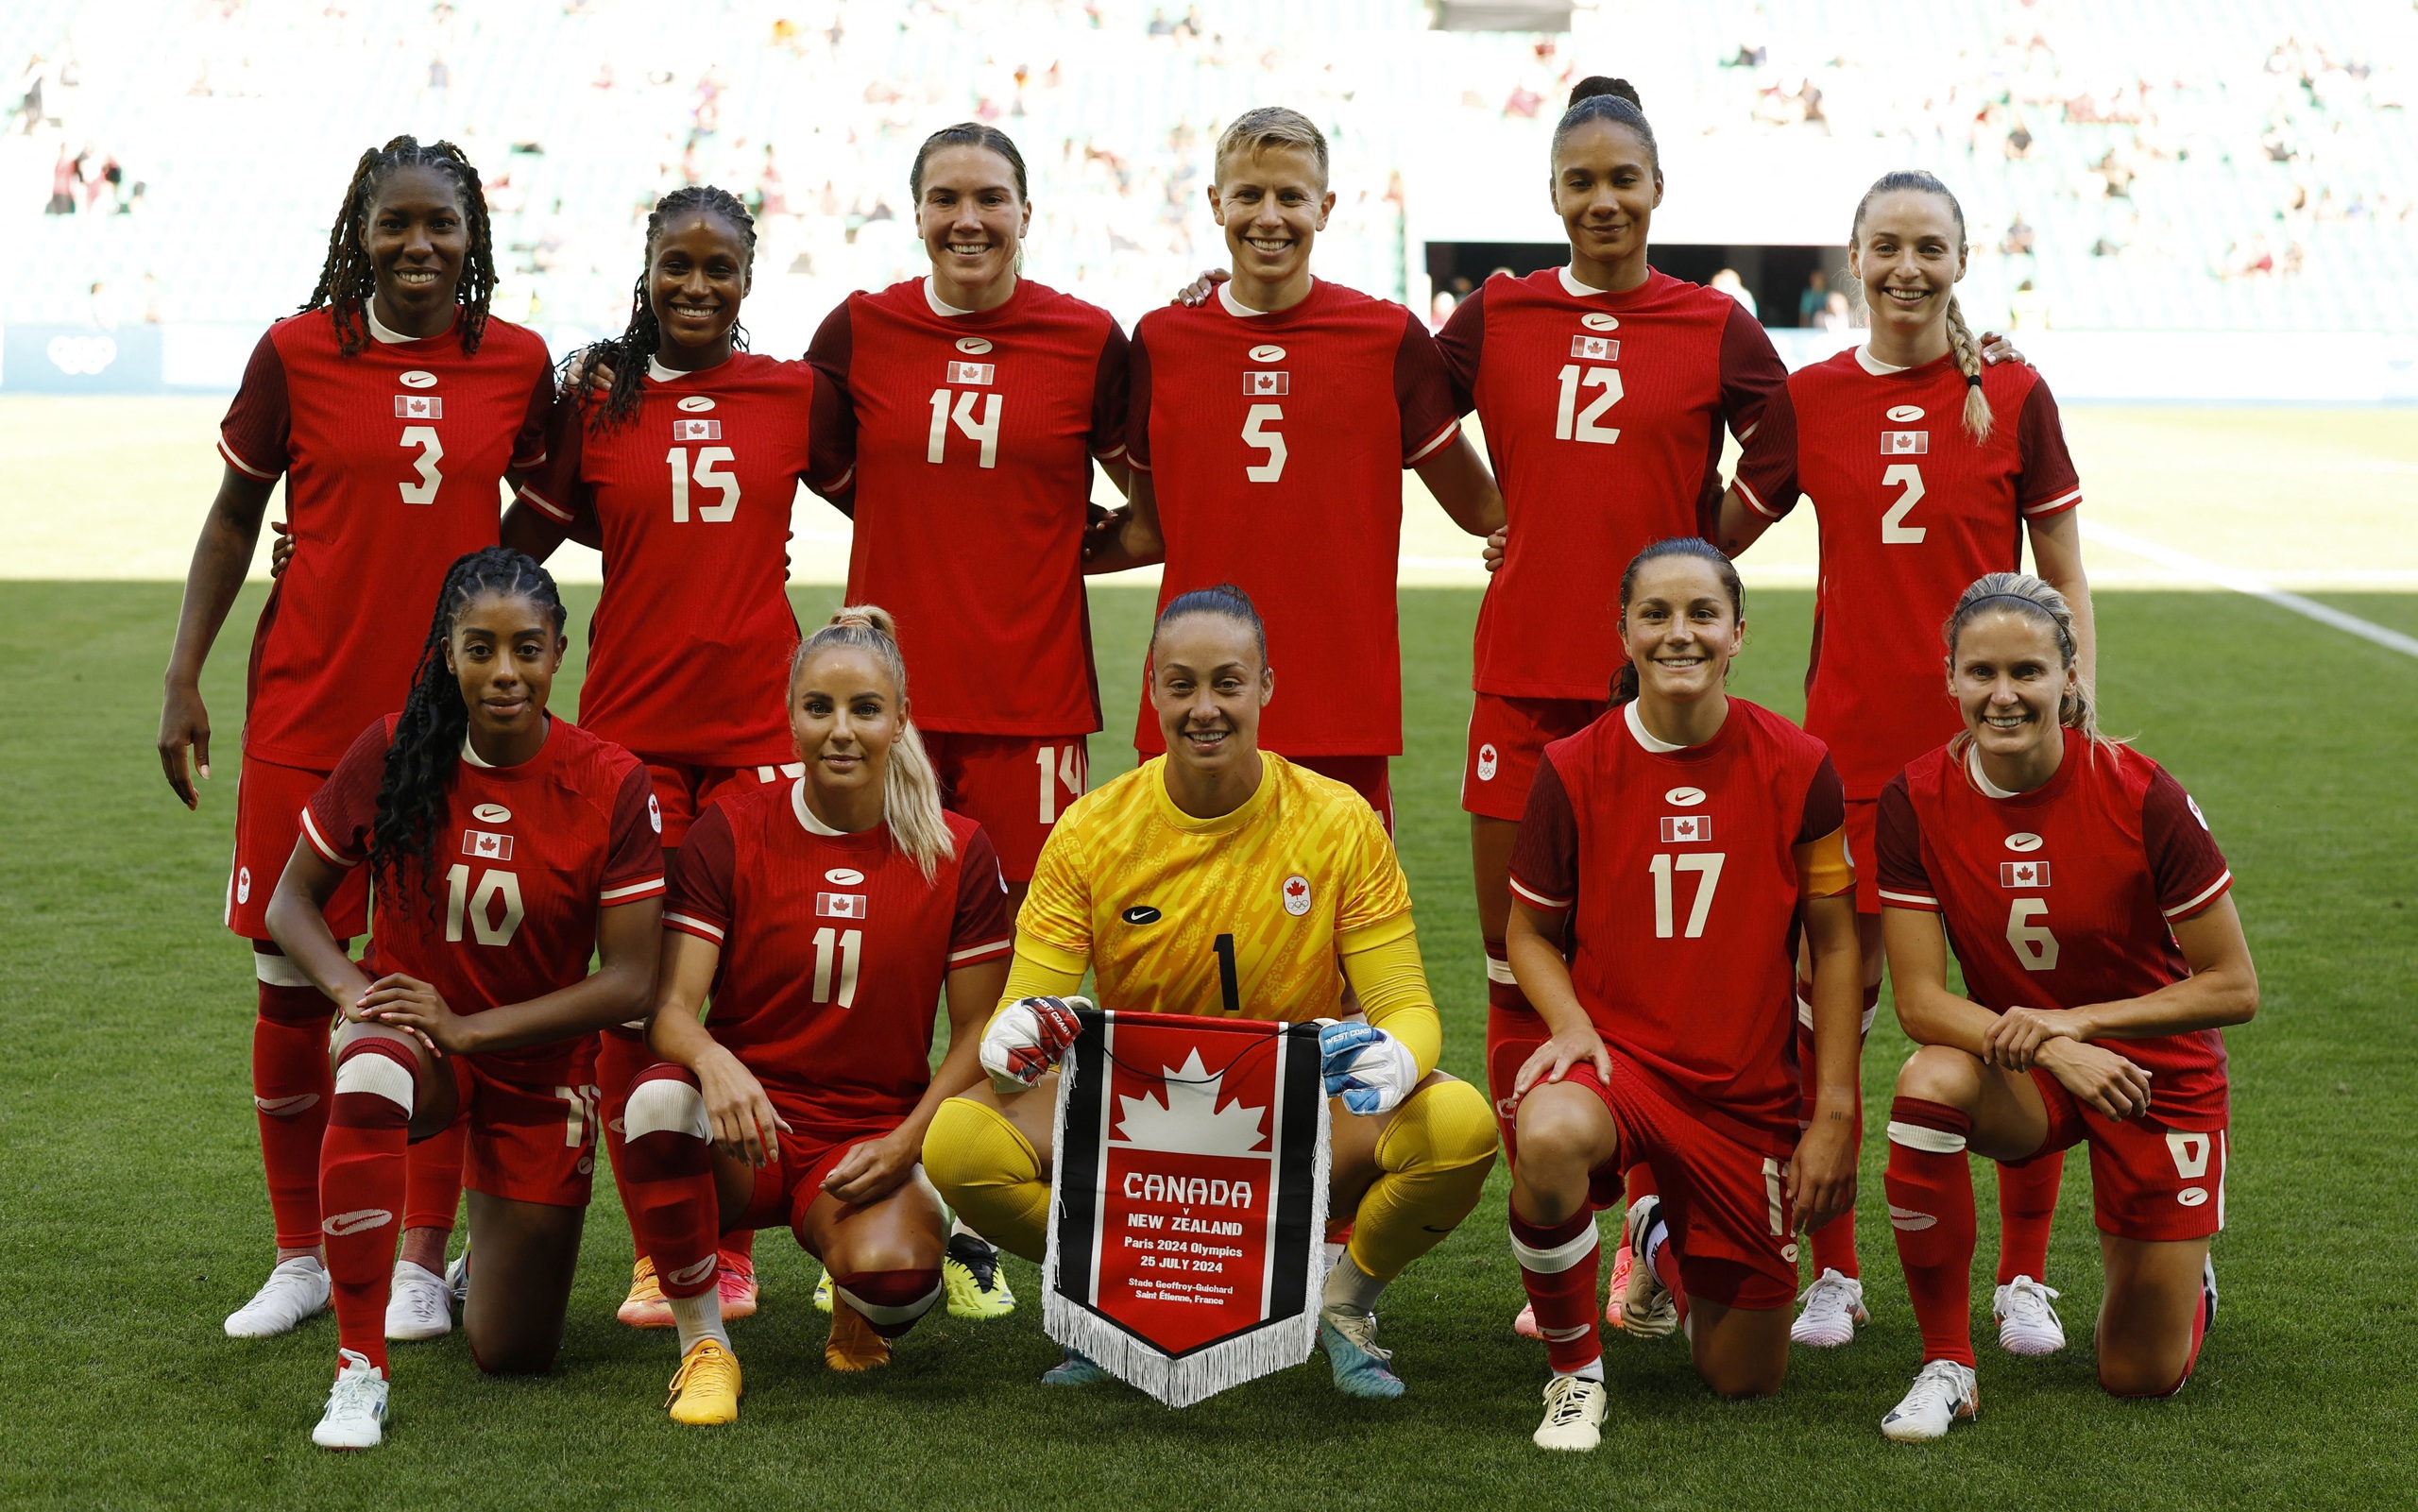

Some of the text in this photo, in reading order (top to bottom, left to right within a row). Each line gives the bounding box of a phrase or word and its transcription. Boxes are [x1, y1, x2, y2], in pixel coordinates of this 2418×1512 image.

[927, 388, 1003, 469] 14
[1556, 364, 1625, 445] 12
[399, 426, 444, 504] 3
[1241, 404, 1288, 483] 5
[665, 447, 741, 522] 15
[1882, 464, 1927, 545] 2
[445, 863, 525, 947] 10
[1648, 853, 1726, 938] 17
[812, 927, 861, 1009] 11
[2006, 898, 2060, 971] 6
[1213, 933, 1240, 1011] 1
[1050, 1011, 1071, 1037] COAST
[1324, 1028, 1371, 1045] WEST COAST
[1123, 1172, 1252, 1209] CANADA
[1128, 1213, 1243, 1237] NEW ZEALAND
[1183, 1207, 1190, 1215] v
[1124, 1236, 1243, 1258] Paris 2024 Olympics
[1140, 1255, 1223, 1273] 25 JULY 2024
[1129, 1277, 1234, 1295] Stade Geoffroy-Guichard
[1135, 1290, 1224, 1305] Saint Étienne, France
